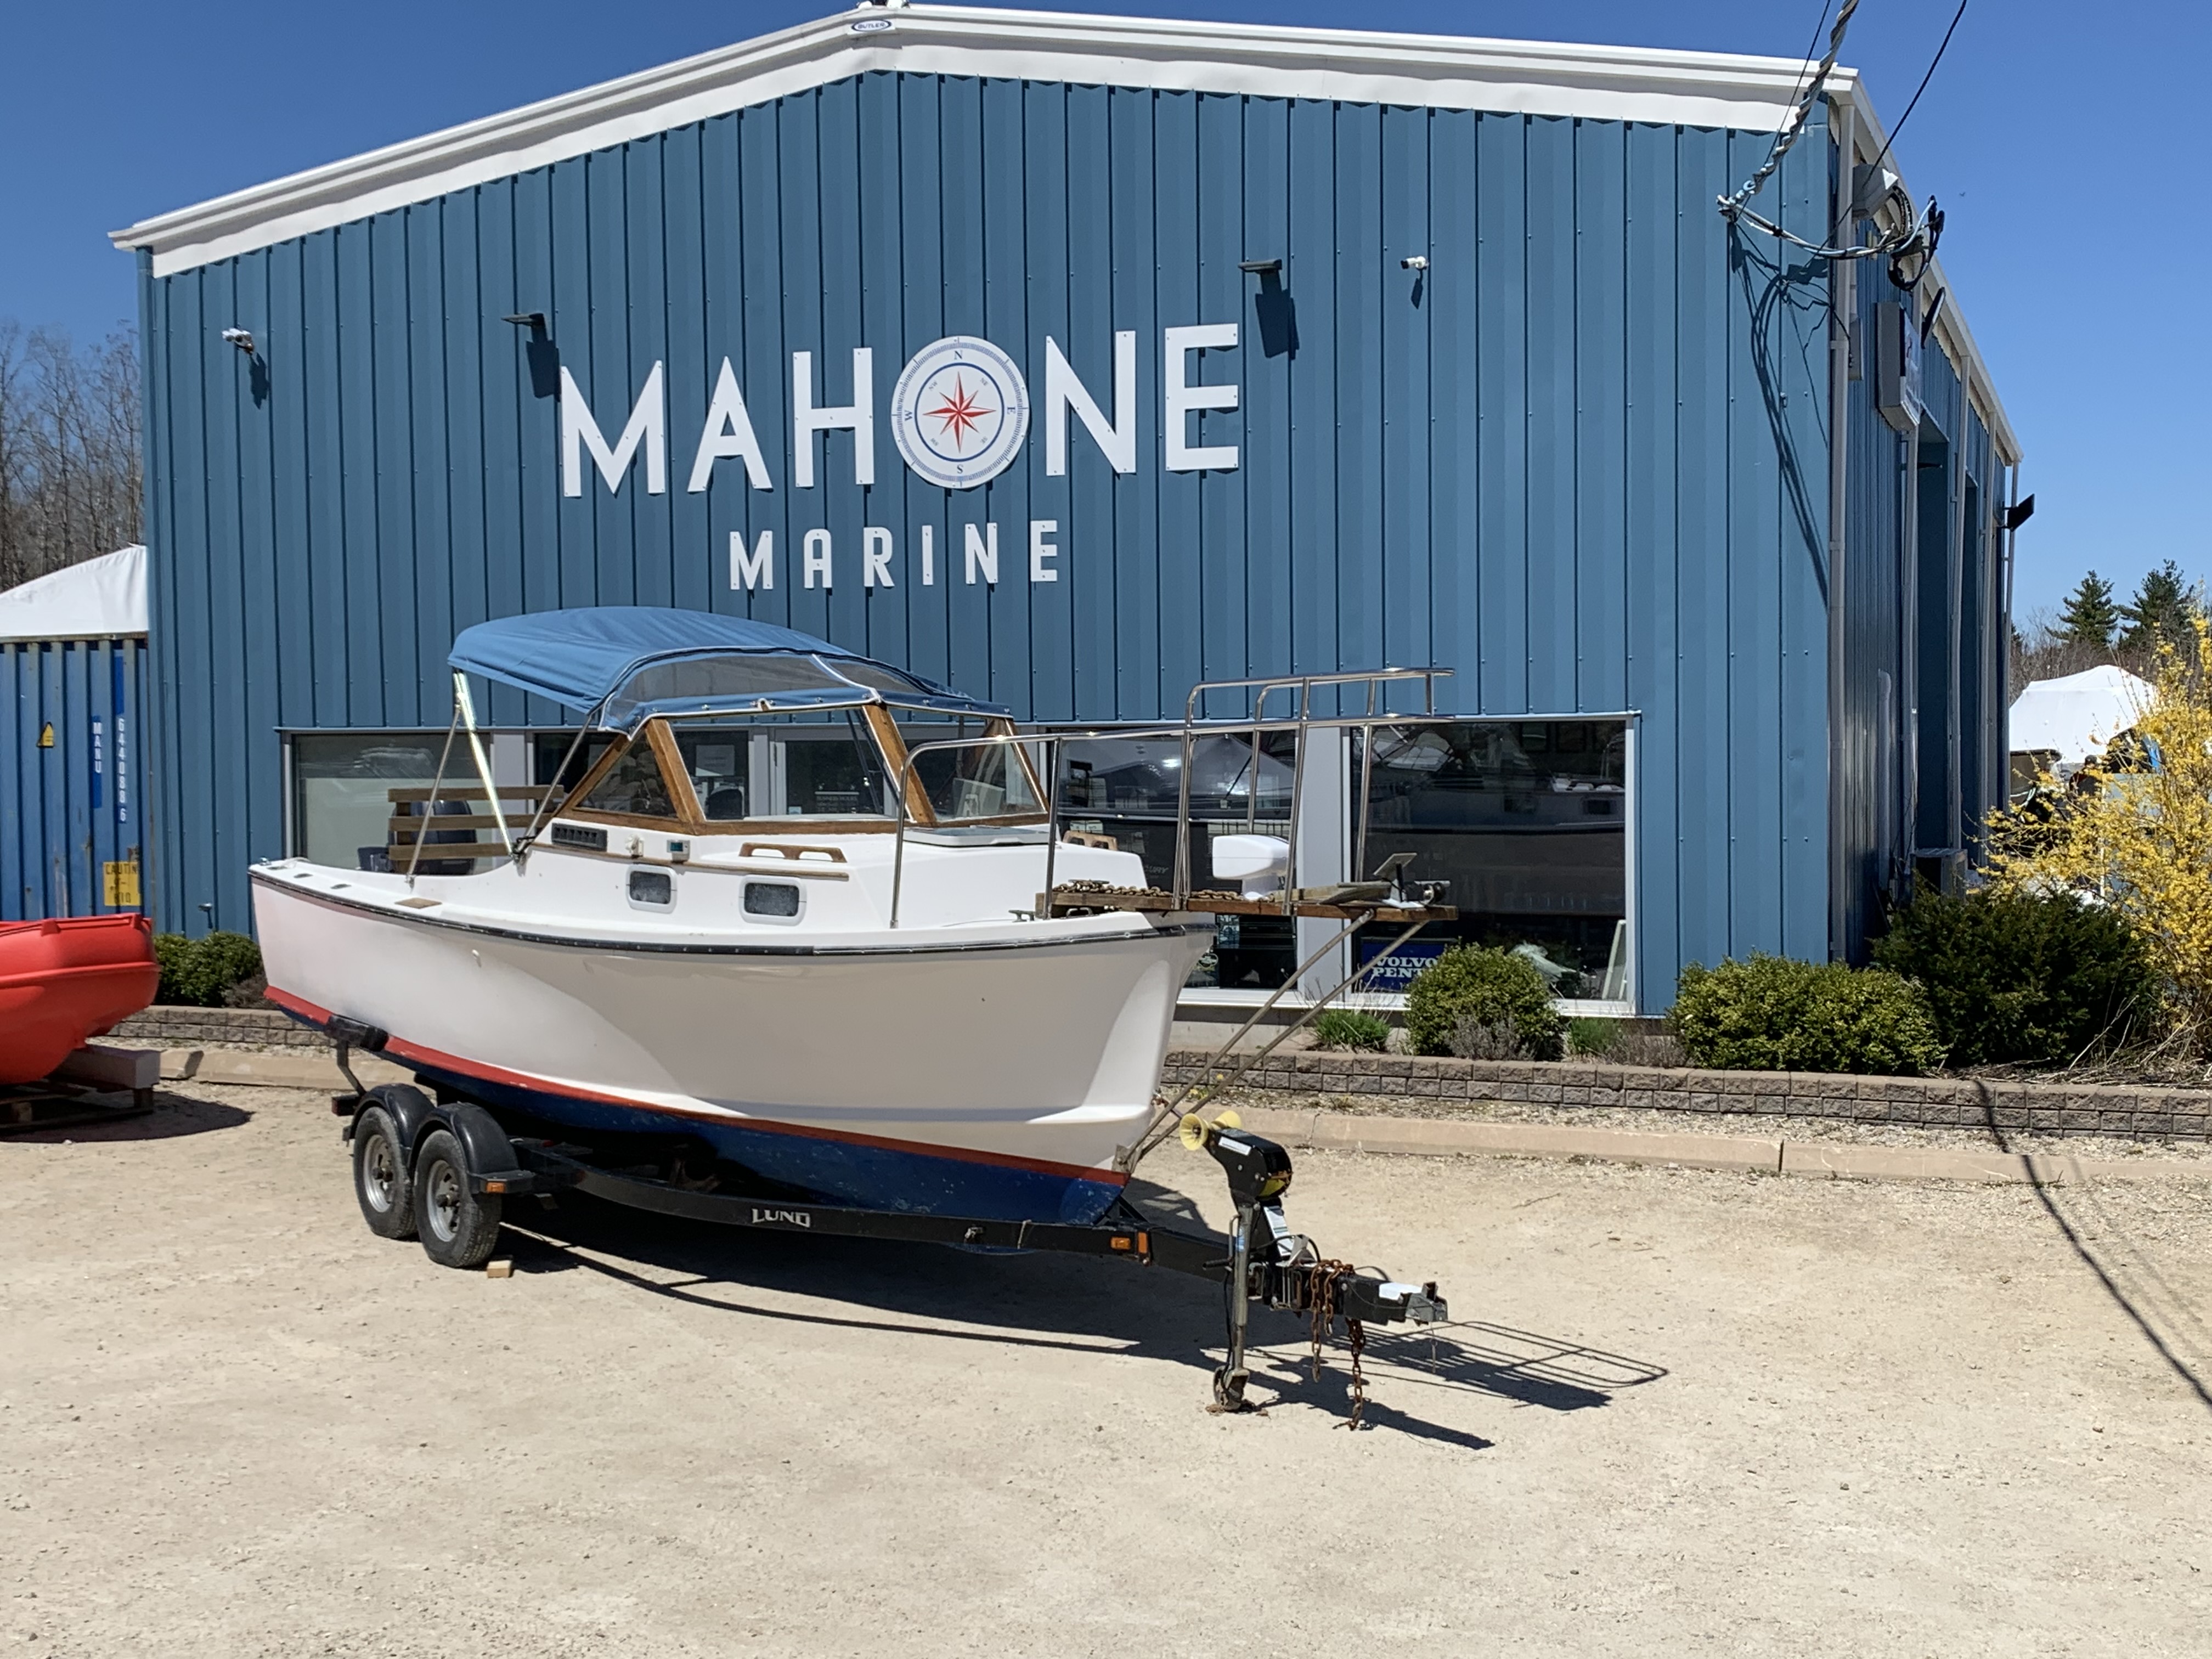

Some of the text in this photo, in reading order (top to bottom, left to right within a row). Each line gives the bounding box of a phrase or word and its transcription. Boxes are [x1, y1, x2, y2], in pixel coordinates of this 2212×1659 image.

[954, 350, 963, 360] N
[561, 323, 1238, 496] MAHONE
[957, 464, 964, 474] S
[730, 520, 1057, 590] MARINE
[1373, 967, 1423, 978] PENT
[752, 1209, 811, 1228] LUND
